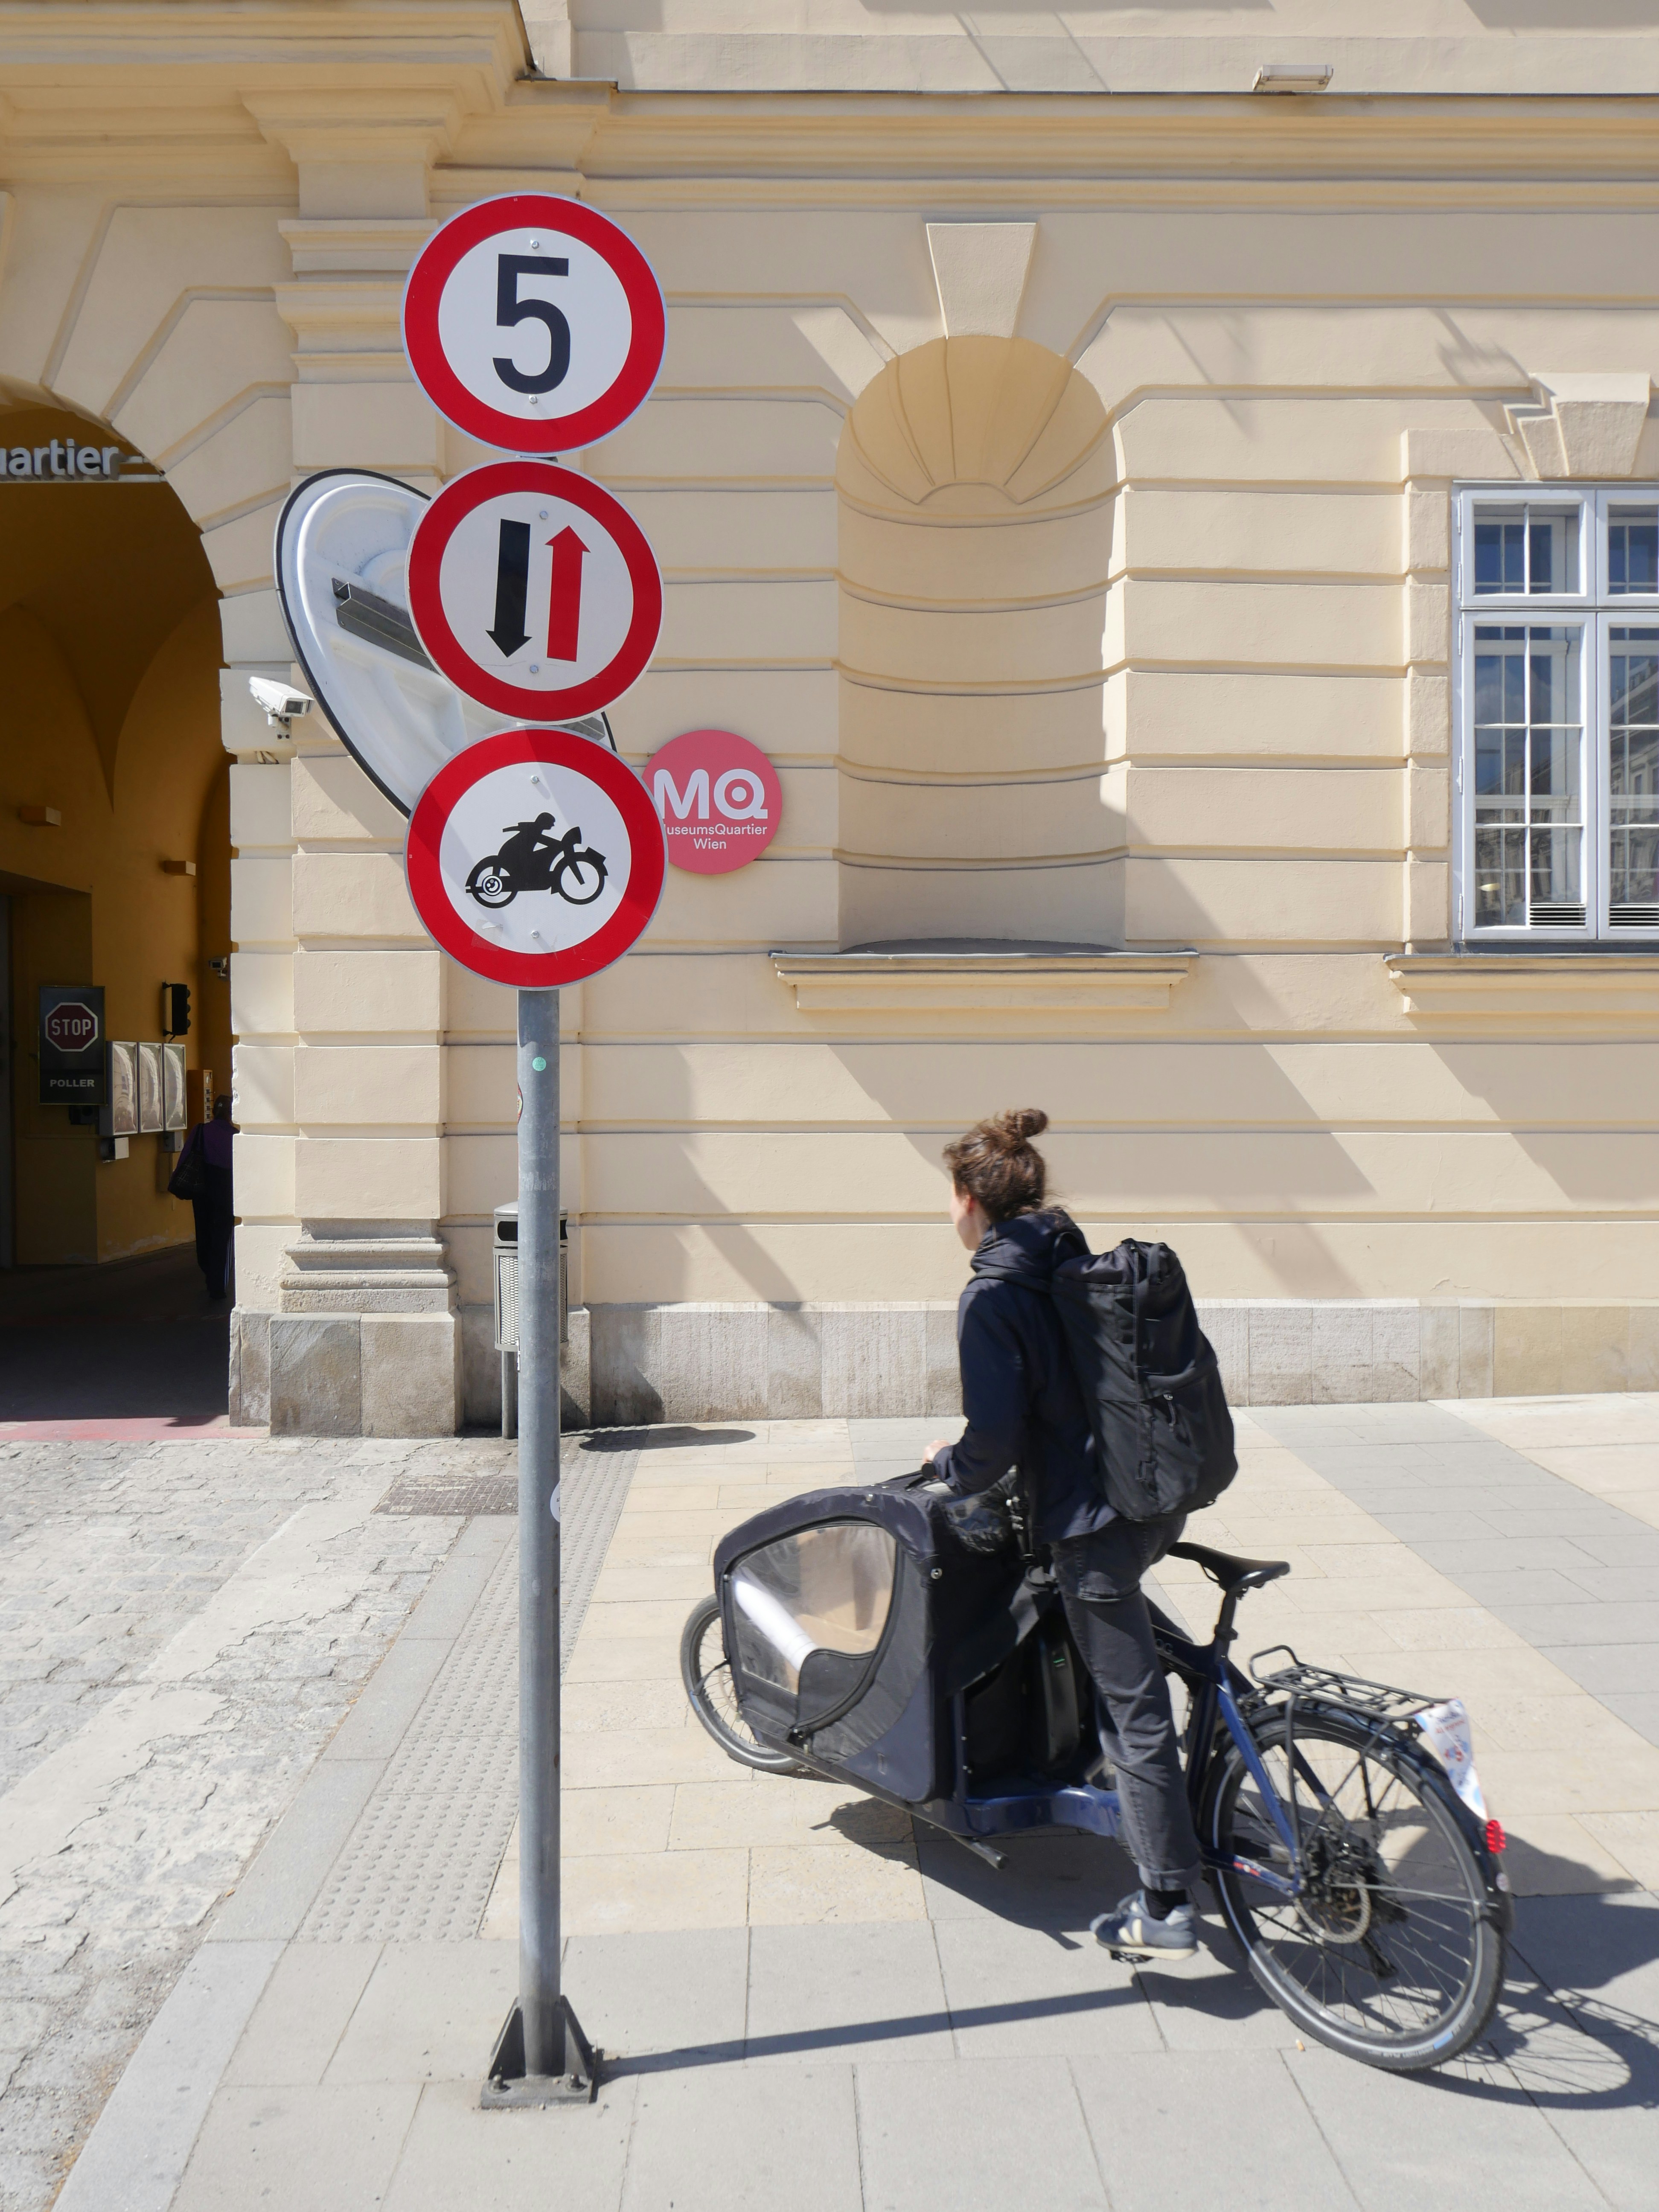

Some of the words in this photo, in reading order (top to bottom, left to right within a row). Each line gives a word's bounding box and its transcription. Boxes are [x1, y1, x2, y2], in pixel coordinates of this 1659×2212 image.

[492, 253, 571, 395] 5
[654, 768, 768, 820] MQ
[664, 823, 768, 835] useumsQuartier
[693, 838, 727, 849] Wien
[51, 1019, 92, 1036] STOP
[49, 1079, 95, 1088] POLLER
